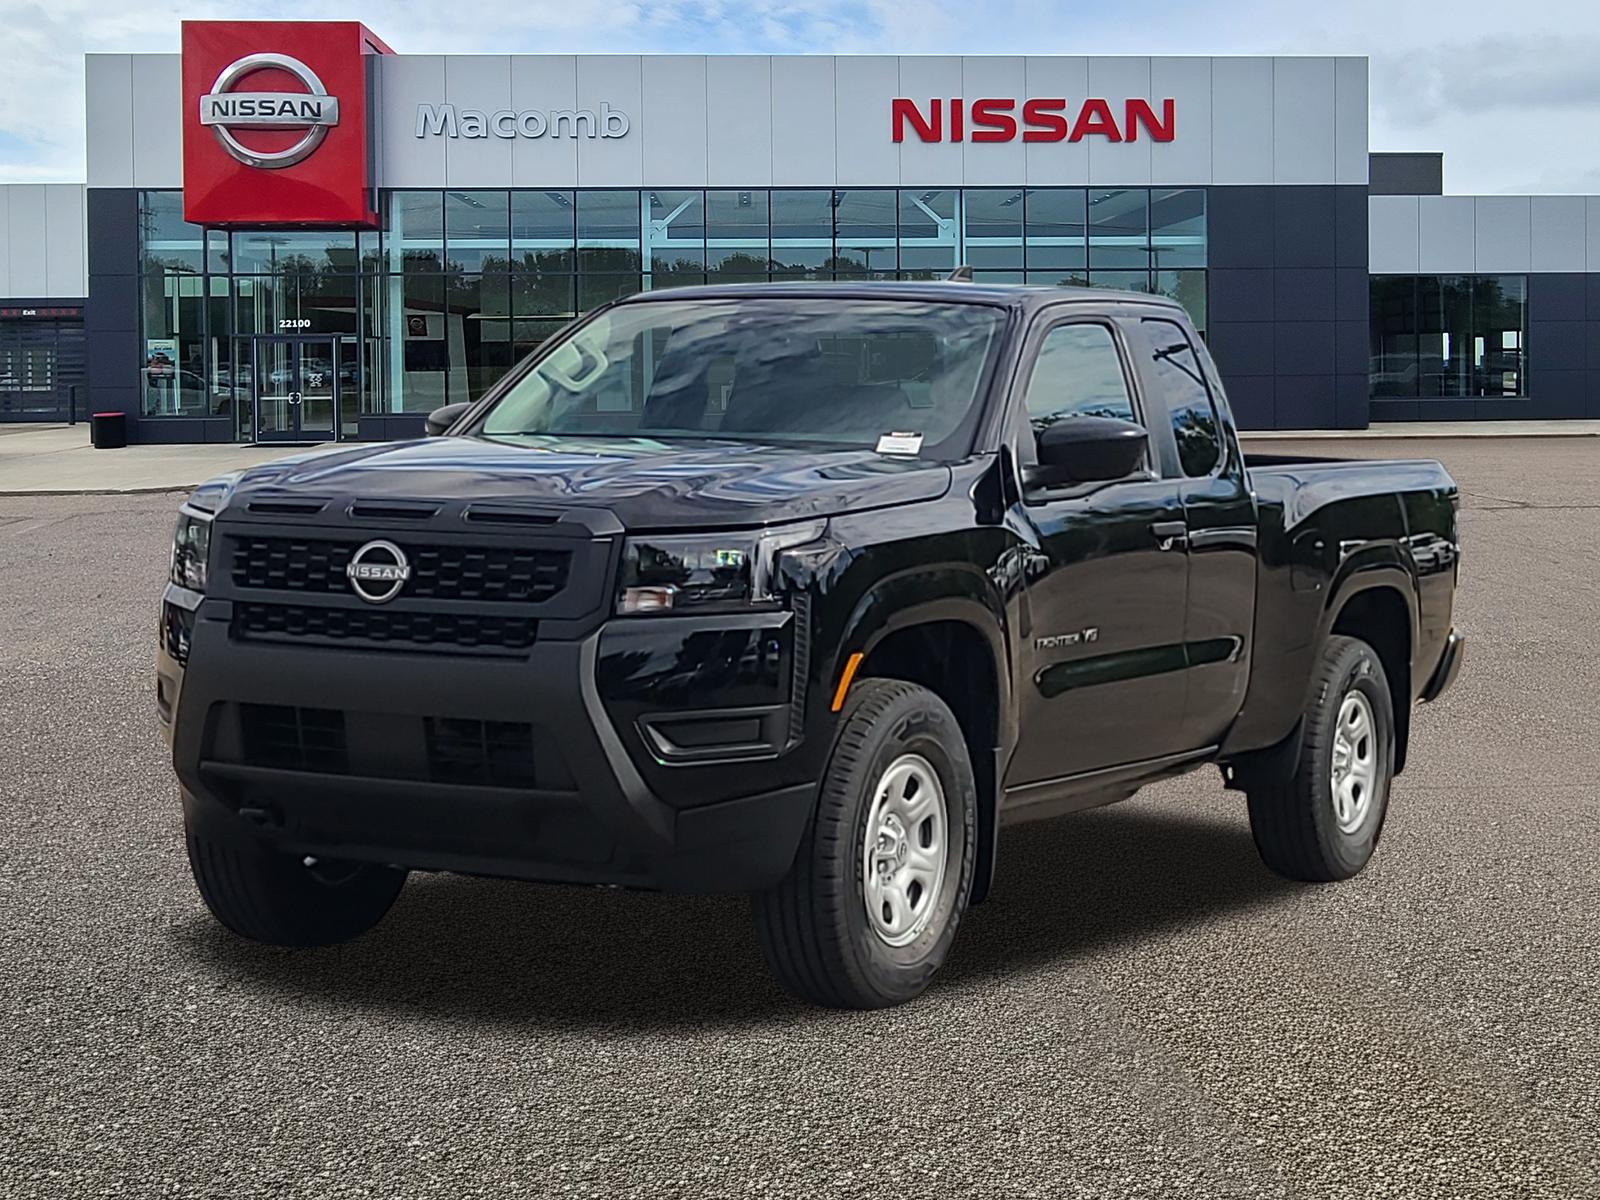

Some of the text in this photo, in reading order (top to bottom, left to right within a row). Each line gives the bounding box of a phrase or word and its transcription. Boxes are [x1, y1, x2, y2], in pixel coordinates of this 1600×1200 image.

[210, 99, 323, 118] NISSAN
[414, 101, 630, 139] Macomb
[891, 97, 1175, 143] NISSAN
[279, 319, 311, 328] 22100
[346, 565, 409, 579] NISSAN
